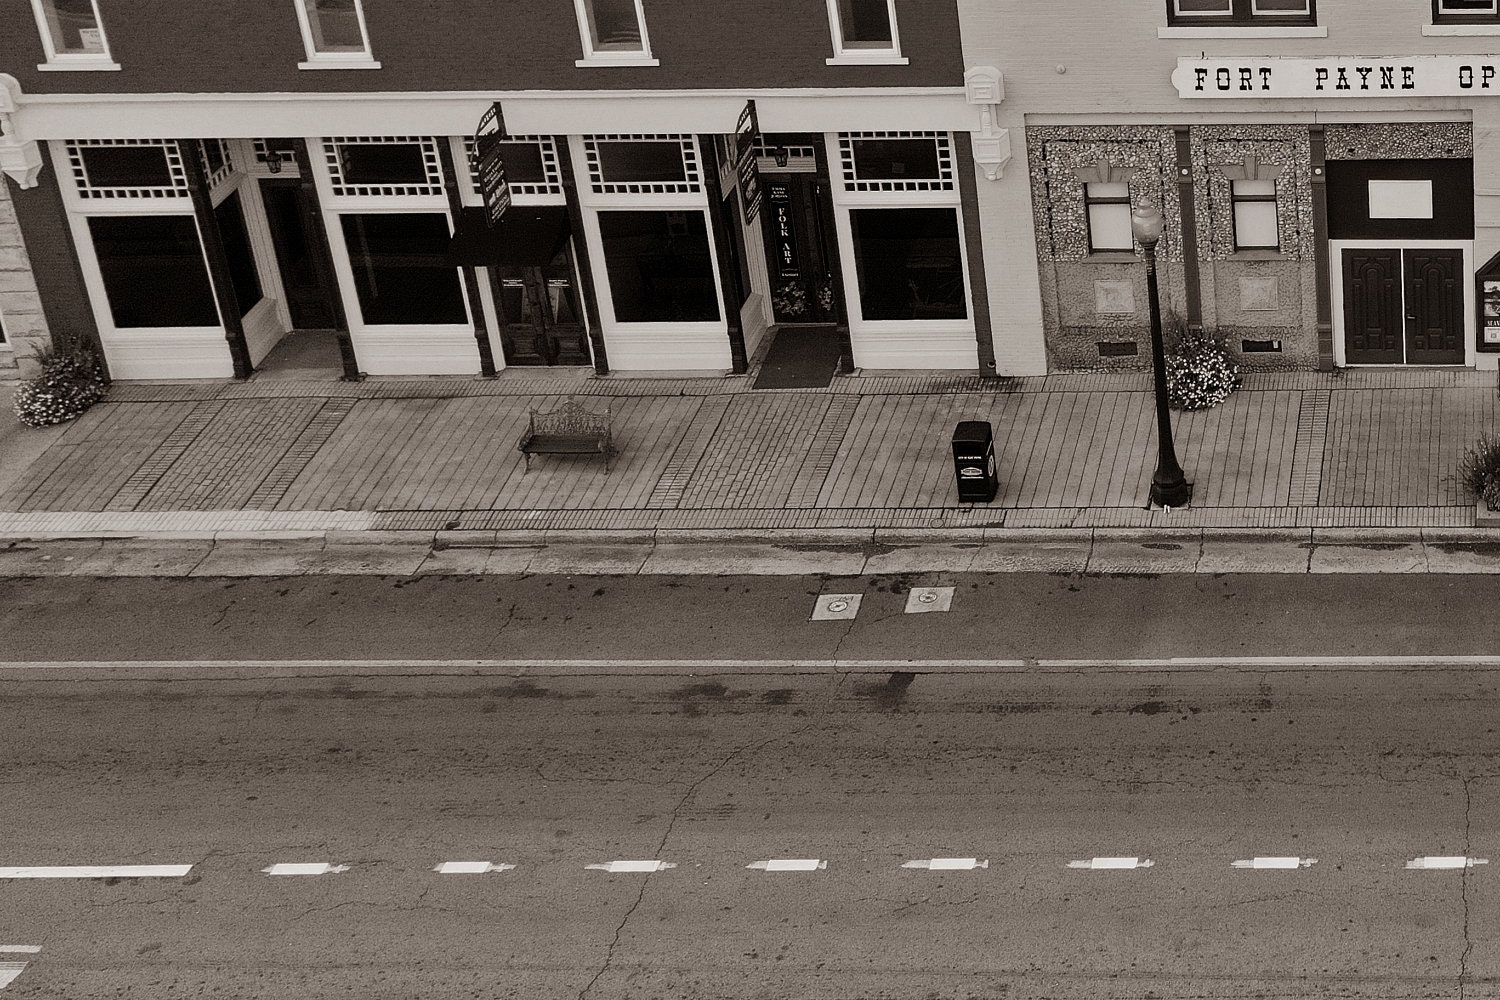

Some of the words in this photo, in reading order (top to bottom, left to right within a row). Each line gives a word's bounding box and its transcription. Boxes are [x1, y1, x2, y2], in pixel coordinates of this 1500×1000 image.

[1194, 67, 1272, 91] FORT
[1315, 66, 1415, 91] PAYNE
[778, 207, 789, 237] FOLK
[782, 242, 792, 264] ART
